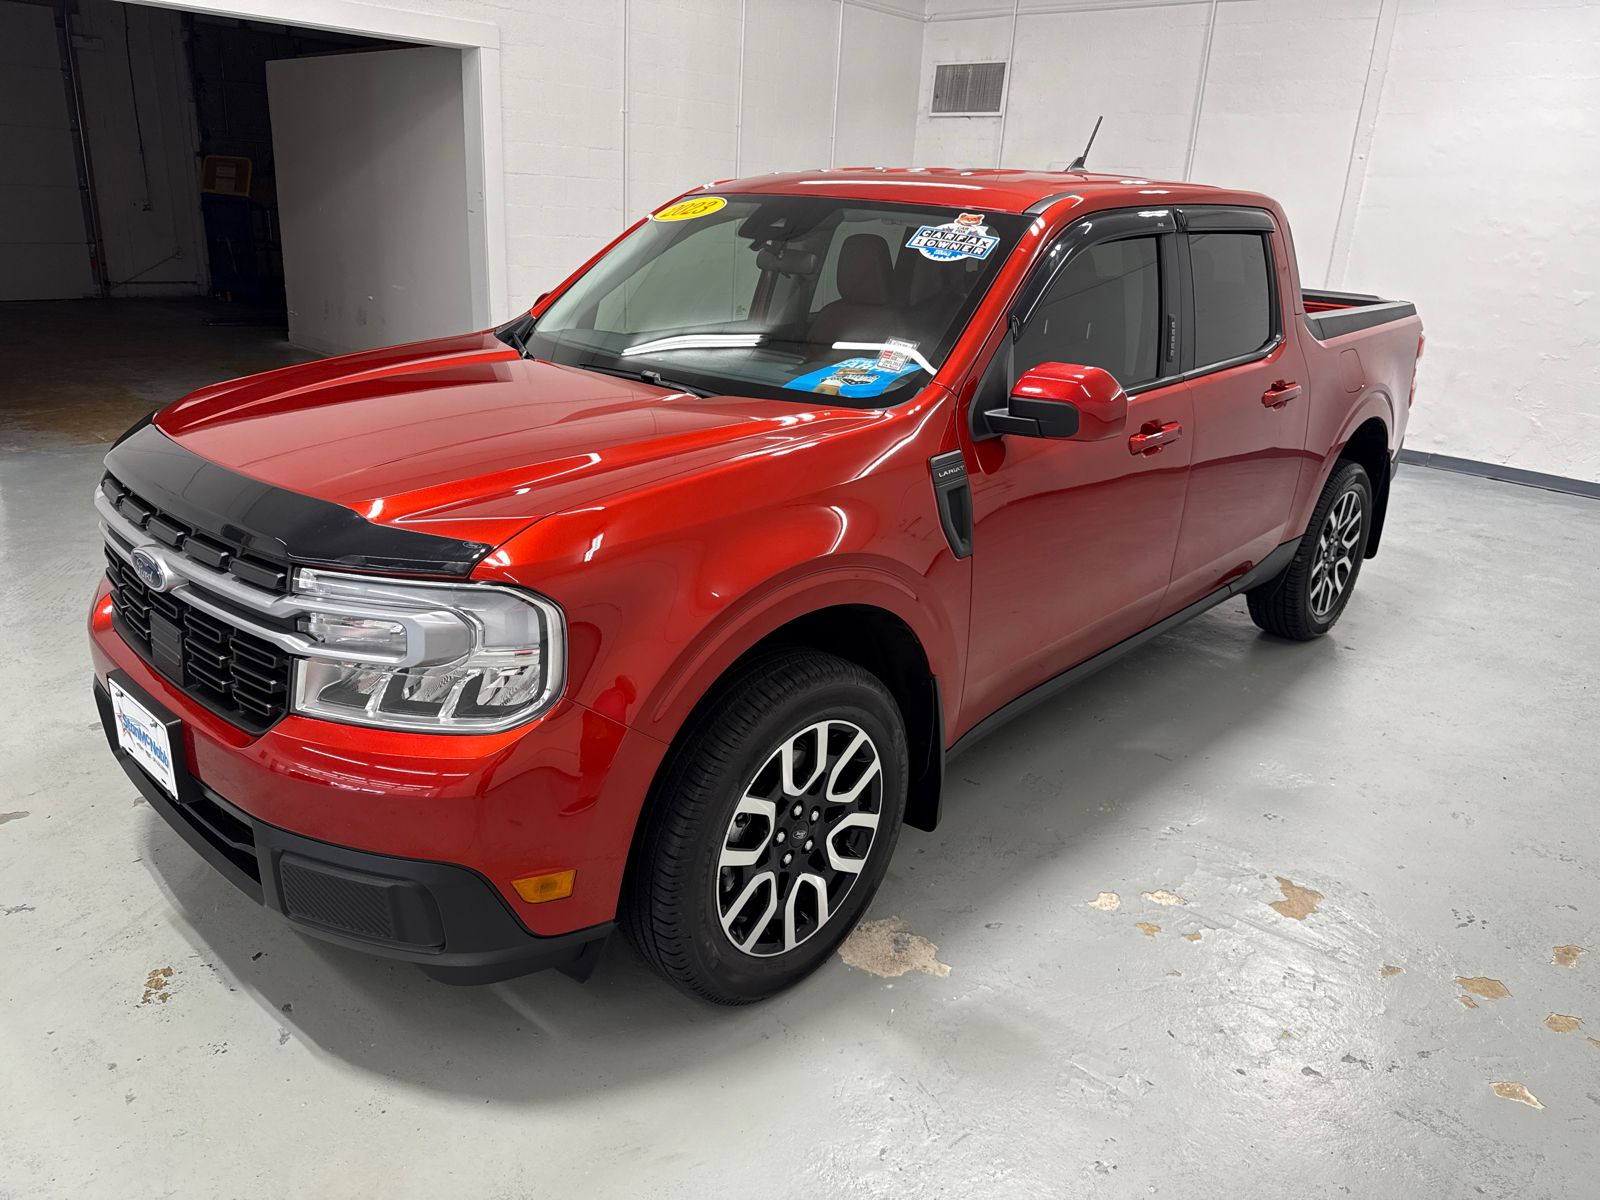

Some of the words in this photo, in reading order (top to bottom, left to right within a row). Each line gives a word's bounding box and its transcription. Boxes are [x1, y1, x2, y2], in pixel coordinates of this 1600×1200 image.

[920, 230, 989, 247] CARFAX
[927, 239, 984, 255] OWNER
[938, 464, 965, 478] LARIAT
[136, 557, 155, 583] Ford
